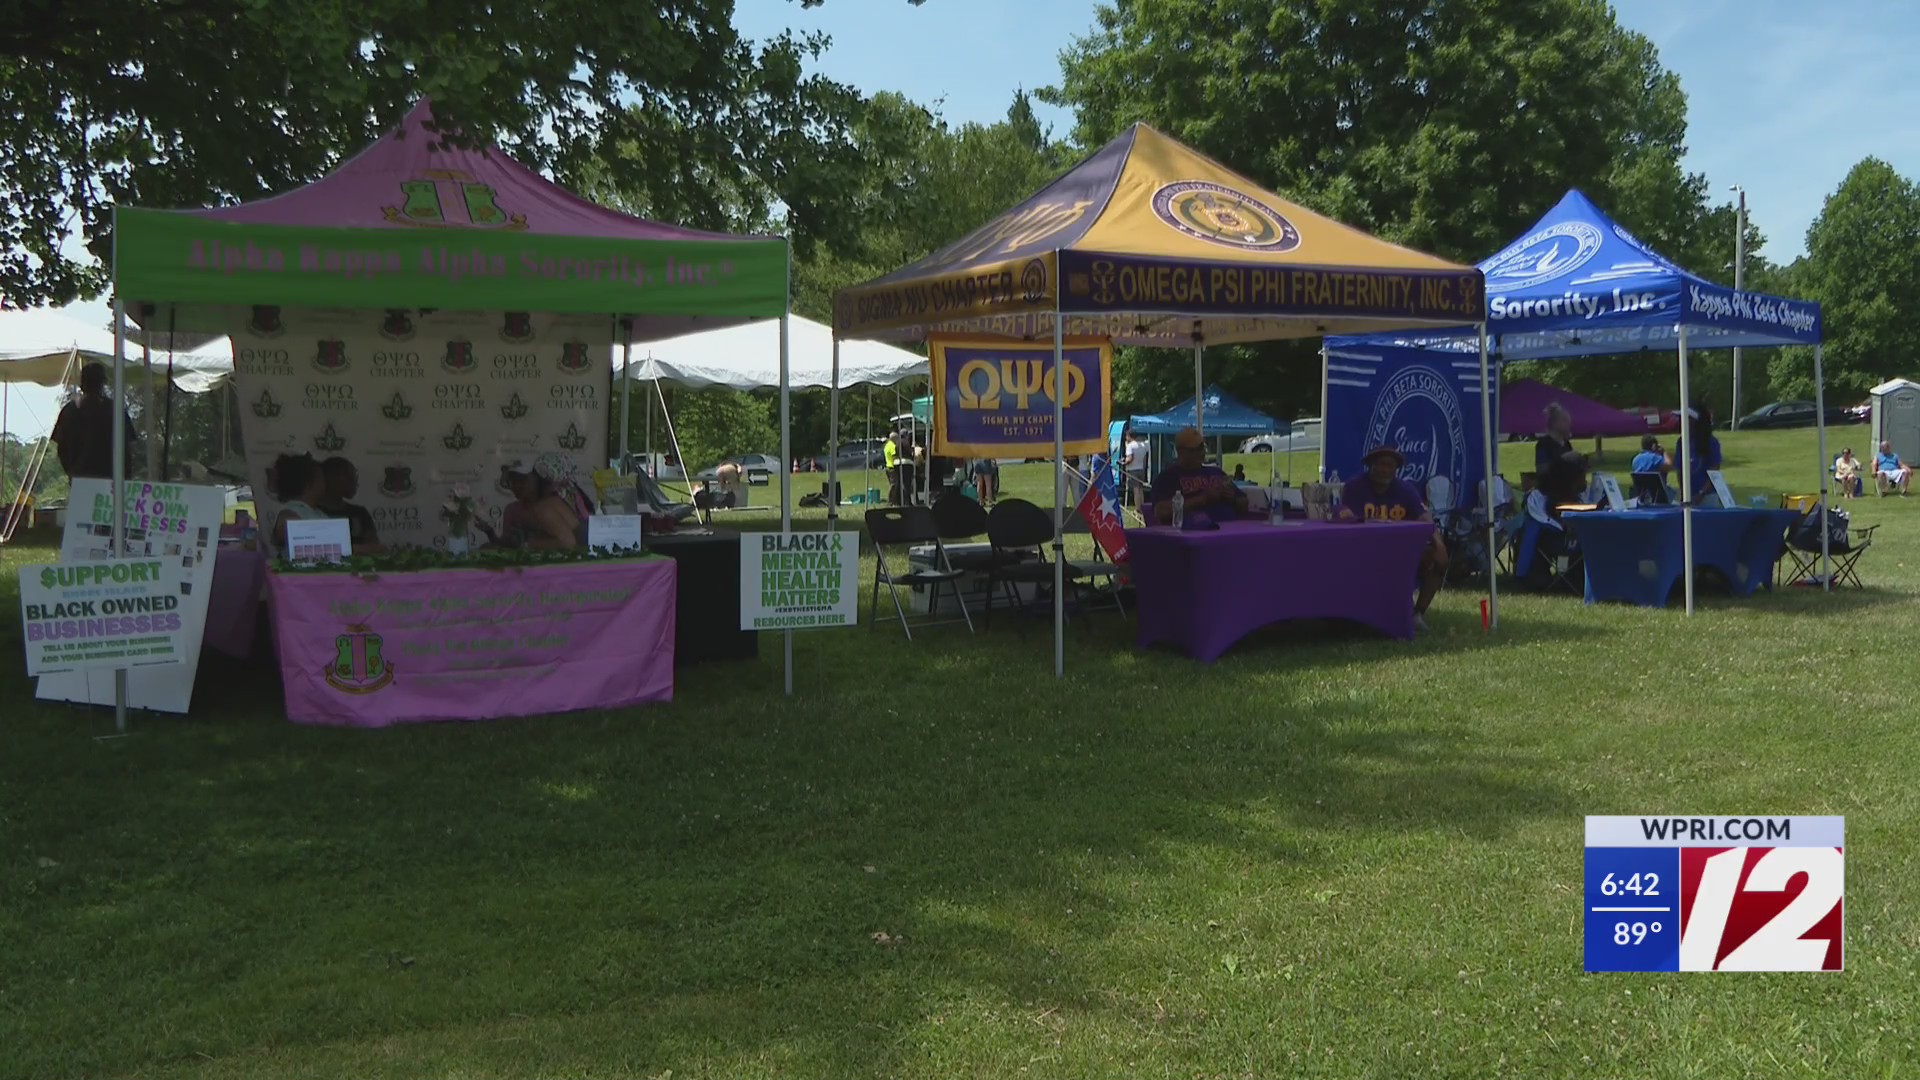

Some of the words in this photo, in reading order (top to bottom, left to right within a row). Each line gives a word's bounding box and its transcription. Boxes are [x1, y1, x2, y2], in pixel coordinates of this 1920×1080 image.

[186, 238, 285, 278] Alpha
[299, 243, 402, 281] Kappa
[417, 245, 507, 285] Alpha
[519, 250, 655, 290] Sorority,
[859, 292, 904, 325] SIGMA
[903, 283, 929, 316] NU
[930, 270, 1014, 312] CHAPTER
[1119, 266, 1205, 304] OMEGA
[1209, 269, 1246, 305] PSI
[1251, 271, 1287, 306] PHI
[1291, 272, 1415, 316] FRATERNITY,
[1418, 278, 1456, 311] INC.
[1490, 291, 1606, 321] Sorority,
[1611, 287, 1667, 314] Inc.
[1689, 284, 1733, 321] Kappa
[1731, 292, 1753, 320] Phi
[1753, 296, 1778, 324] Zeta
[1777, 301, 1816, 335] Chapter
[957, 358, 1086, 410] ΩΨΦ
[1379, 391, 1397, 421] PHI
[1393, 374, 1418, 400] BETA
[981, 414, 1010, 425] SIGMA
[1012, 414, 1025, 425] NU
[1027, 413, 1056, 425] CHAPT
[1394, 426, 1428, 453] Since
[95, 493, 147, 513] BLCK
[93, 509, 187, 533] BUINESSES
[762, 534, 828, 551] BLACK
[762, 552, 842, 571] MENTAL
[41, 562, 162, 590] $UPPORT
[762, 570, 841, 591] HEALTH
[26, 600, 97, 620] BLACK
[101, 596, 178, 615] OWNED
[762, 590, 840, 608] MATTERS
[27, 613, 181, 641] BUSINESSES
[753, 615, 816, 628] RESOURCES
[818, 614, 846, 625] HERE
[78, 639, 104, 650] ABOUT
